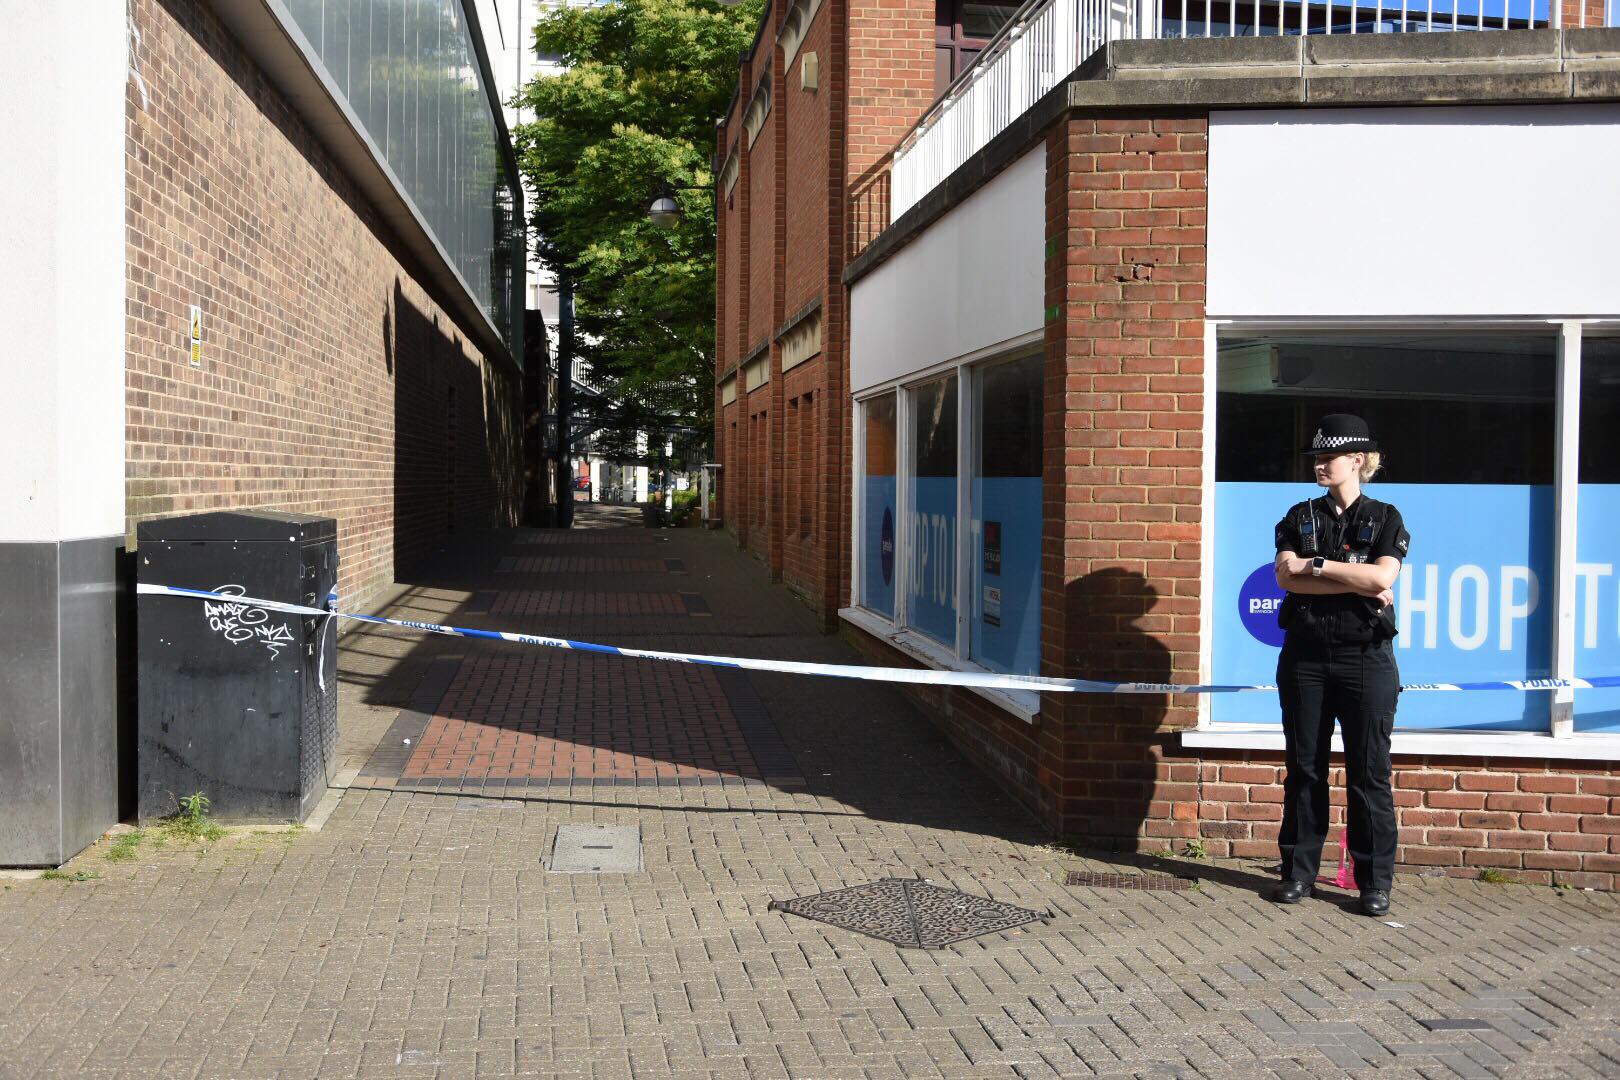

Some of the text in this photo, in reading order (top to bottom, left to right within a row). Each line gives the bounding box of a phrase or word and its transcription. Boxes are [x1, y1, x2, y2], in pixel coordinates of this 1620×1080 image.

[1249, 598, 1284, 614] par
[1398, 562, 1620, 650] HOP T
[1520, 678, 1570, 689] POLICE
